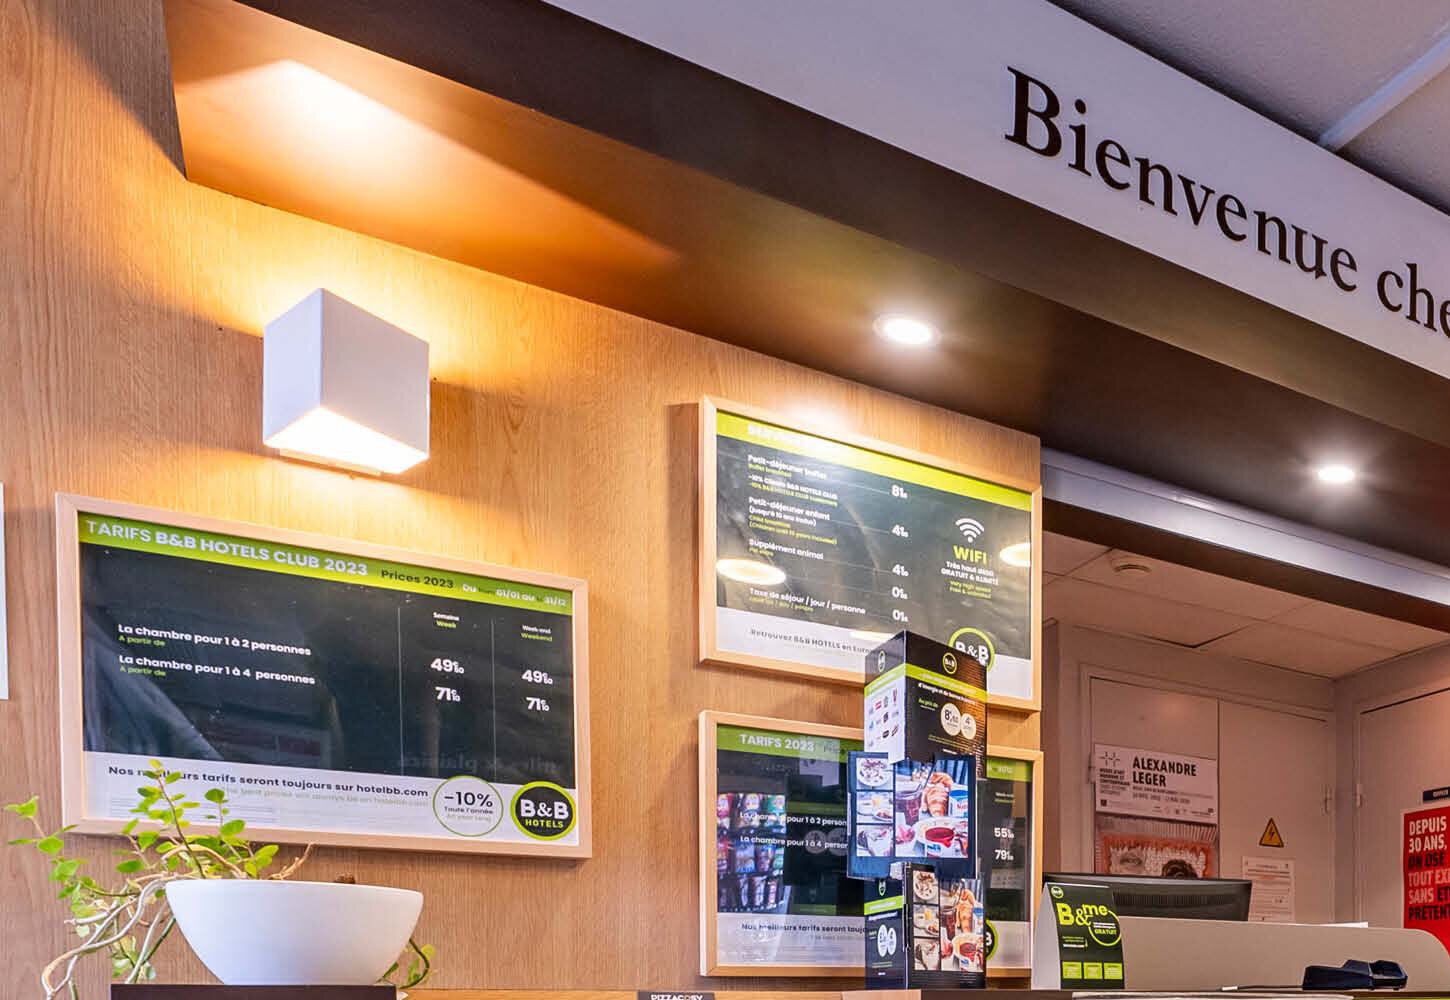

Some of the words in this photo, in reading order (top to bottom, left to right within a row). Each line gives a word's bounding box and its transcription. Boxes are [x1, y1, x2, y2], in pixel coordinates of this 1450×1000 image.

[1004, 66, 1357, 292] Bienvenue
[87, 520, 151, 542] TARIFS
[155, 531, 197, 549] B&B
[200, 538, 270, 560] HOTELS
[273, 550, 319, 569] CLUB
[324, 557, 368, 576] 2023
[953, 545, 987, 565] WIFI
[381, 569, 421, 584] Prices
[424, 575, 454, 589] 2023
[831, 602, 866, 615] personne
[118, 624, 133, 635] La
[135, 625, 192, 641] chambre
[194, 633, 222, 645] pour
[224, 637, 230, 646] 1
[232, 635, 240, 647] à
[242, 639, 250, 648] 2
[251, 641, 312, 656] personnes
[119, 655, 134, 665] La
[135, 655, 193, 672] chambre
[194, 663, 223, 675] pour
[225, 666, 230, 675] 1
[232, 666, 240, 677] à
[242, 668, 251, 677] 4
[255, 670, 315, 685] personnes
[739, 734, 782, 748] TARIFS
[785, 739, 814, 753] 2023
[1132, 756, 1197, 777] ALEXANDRE
[108, 766, 134, 777] Nos
[202, 772, 236, 783] tarifs
[239, 776, 280, 787] seront
[282, 779, 333, 791] toujours
[334, 783, 354, 792] sur
[356, 784, 428, 798] hotelbb.com
[1132, 771, 1166, 788] LEGER
[520, 799, 569, 820] B&B
[787, 815, 804, 824] pour
[525, 818, 564, 829] HOTELS
[1408, 816, 1448, 836] DEPUIS
[787, 839, 804, 847] pour
[1408, 837, 1422, 854] 30
[1407, 854, 1423, 871] ON
[1425, 851, 1445, 868] OSE
[1407, 870, 1434, 887] TOUT
[1408, 887, 1435, 905] SANS
